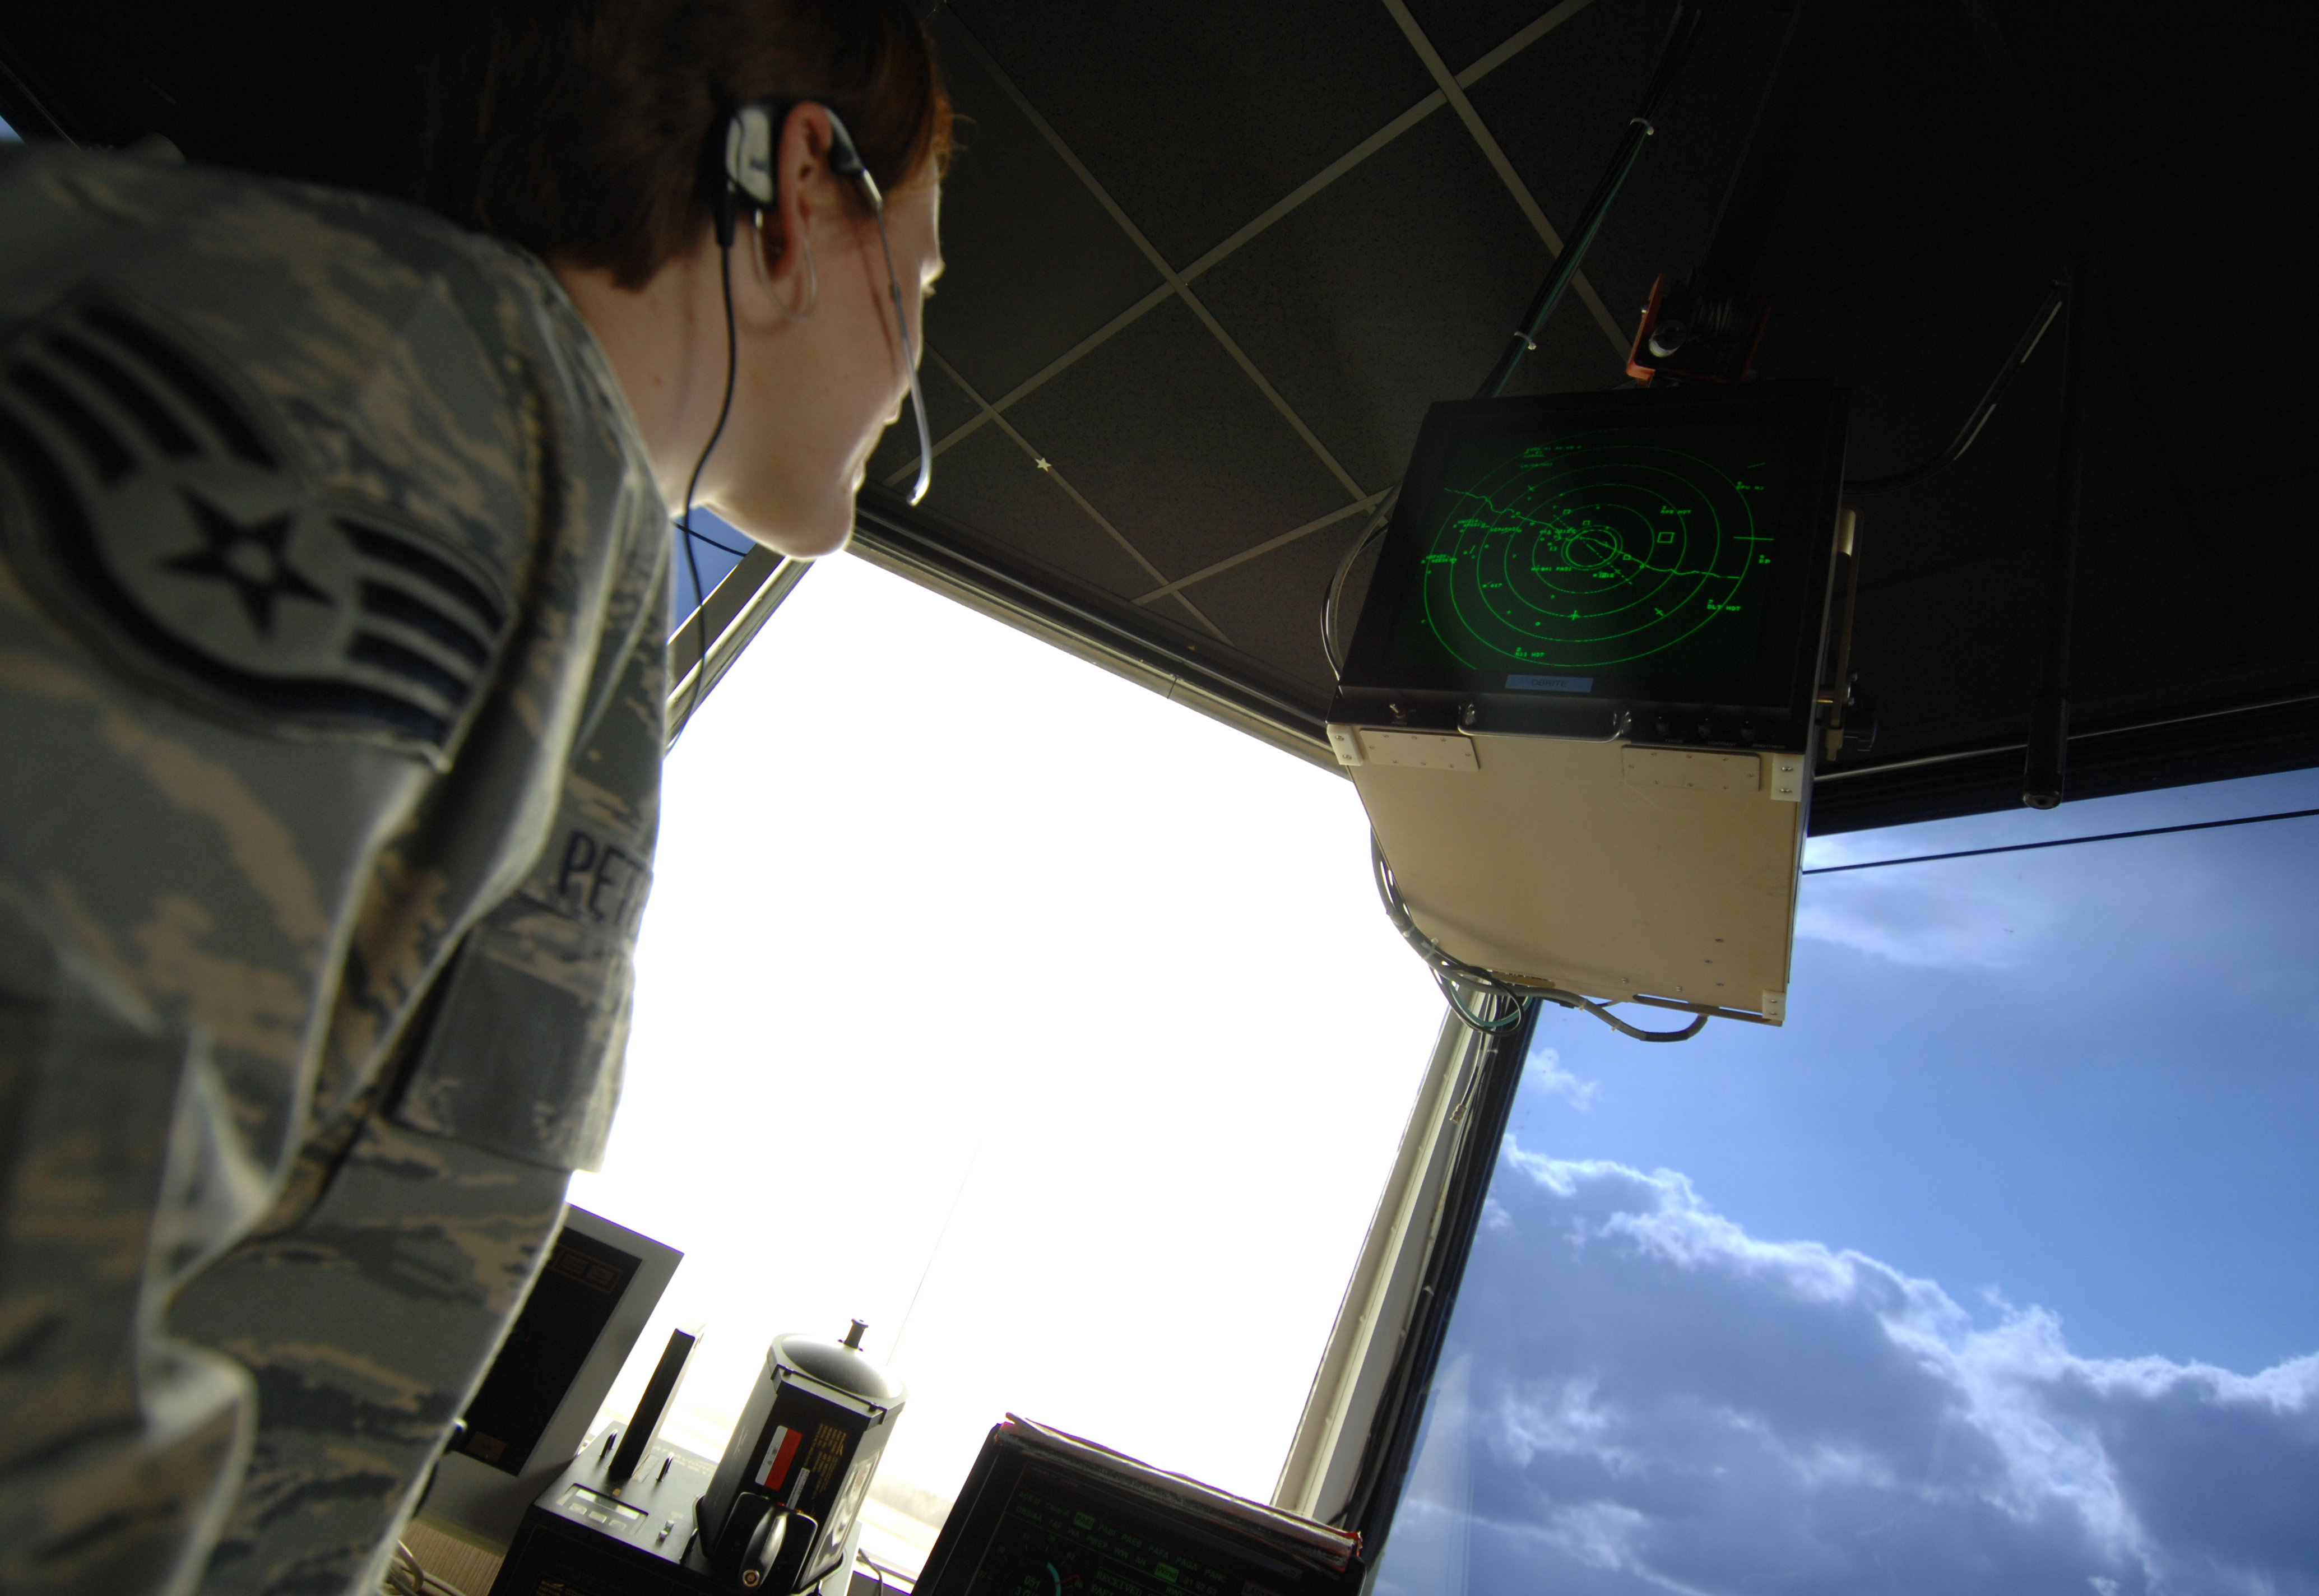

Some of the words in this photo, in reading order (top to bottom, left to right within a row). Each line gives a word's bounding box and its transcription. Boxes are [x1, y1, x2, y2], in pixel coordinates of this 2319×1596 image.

[1086, 1535, 1108, 1549] PIREP
[1157, 1565, 1177, 1579] Wind
[1148, 1545, 1169, 1560] PAFA
[1024, 1575, 1041, 1590] 051
[1097, 1571, 1142, 1596] RECEIVED
